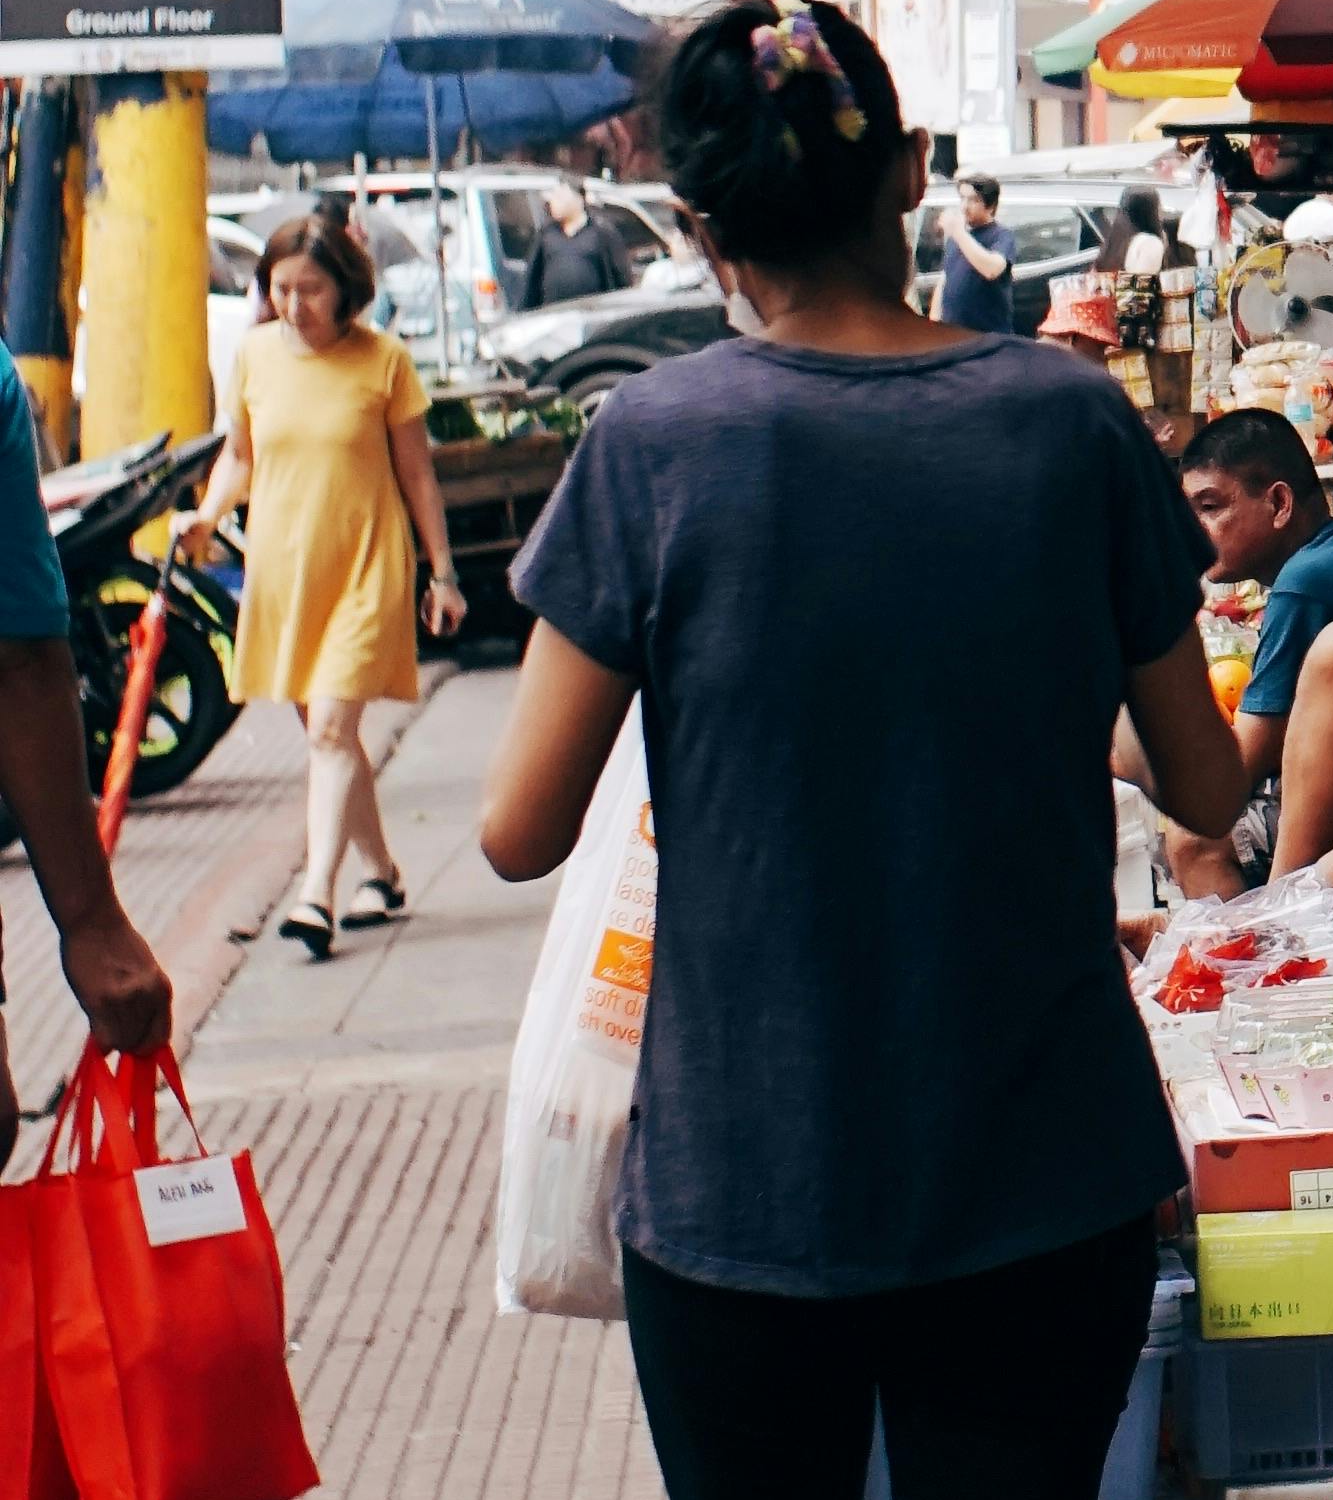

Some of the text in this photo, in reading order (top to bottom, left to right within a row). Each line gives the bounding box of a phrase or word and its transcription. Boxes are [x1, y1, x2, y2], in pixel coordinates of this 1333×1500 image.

[65, 5, 214, 35] Ground Floor
[1300, 1195, 1313, 1205] 16
